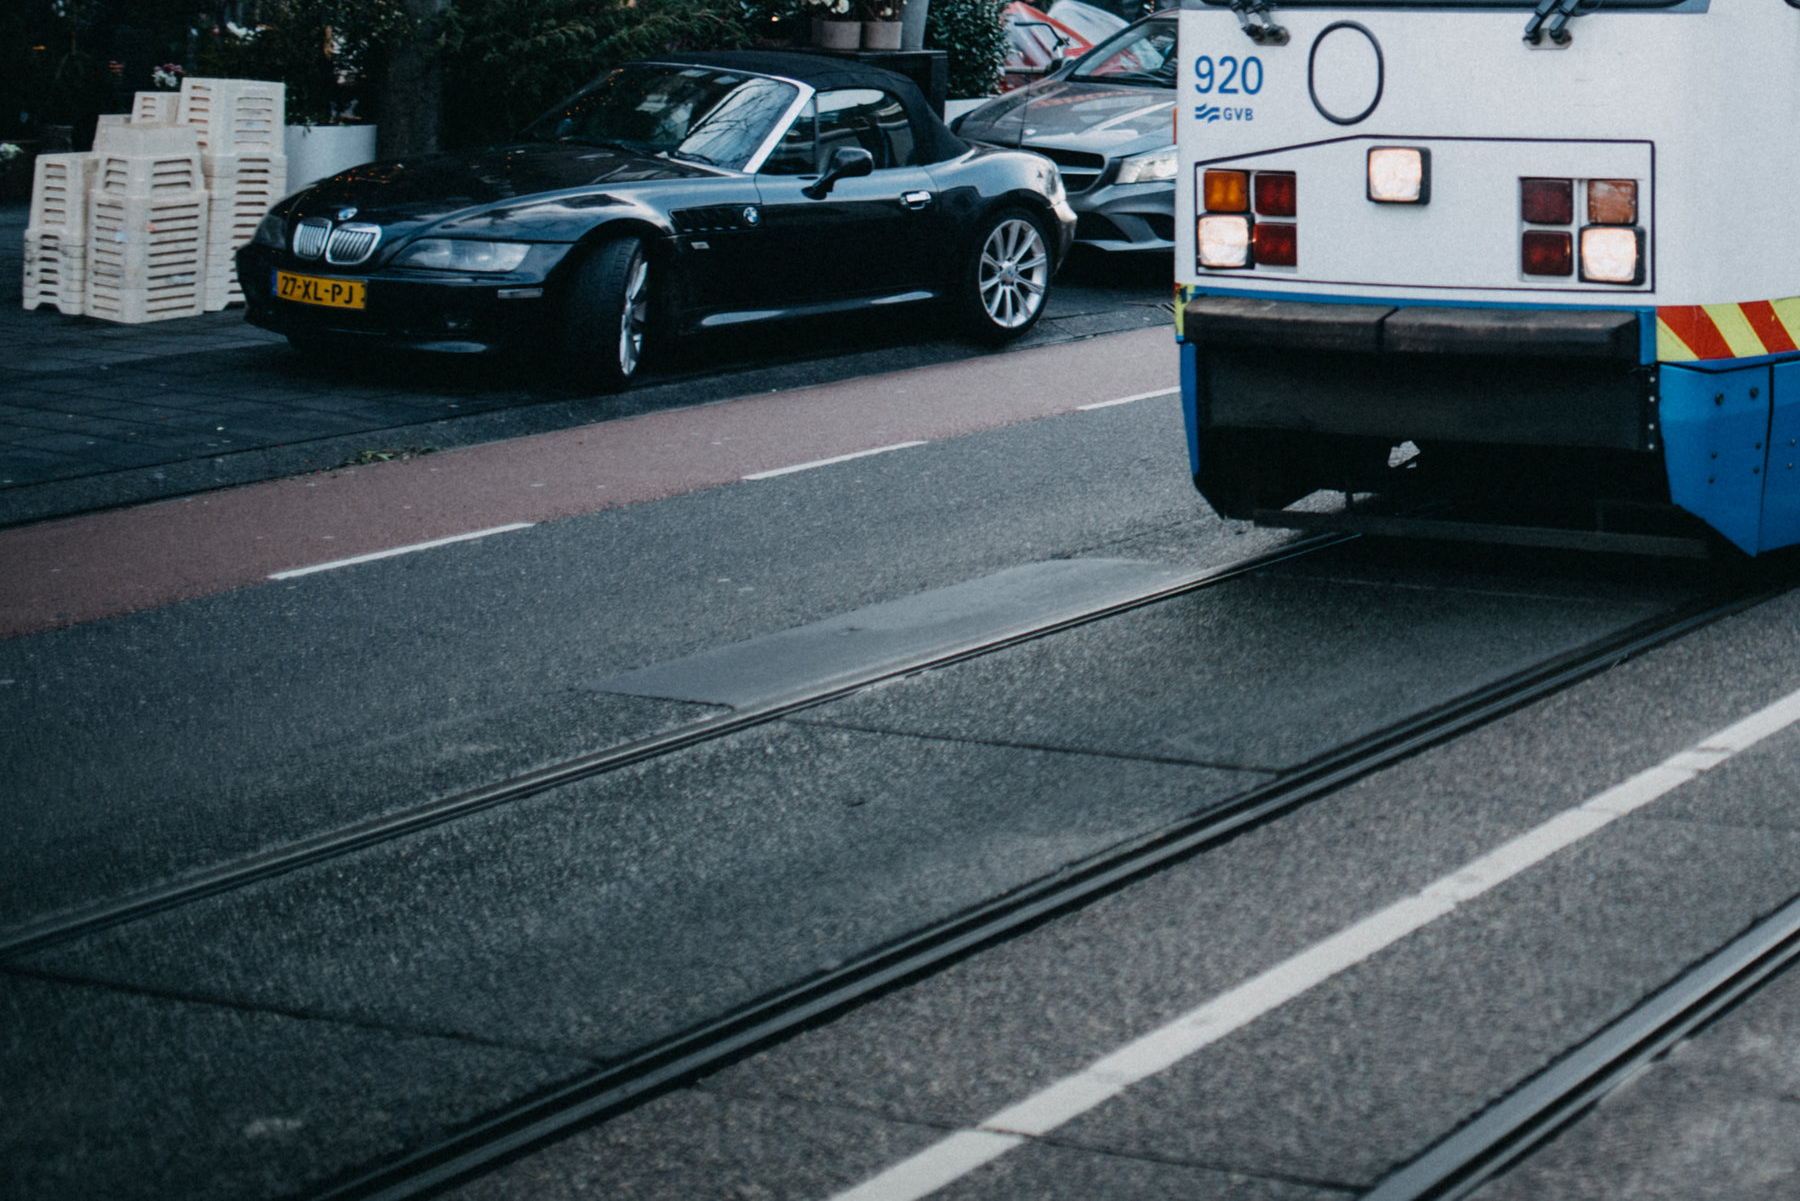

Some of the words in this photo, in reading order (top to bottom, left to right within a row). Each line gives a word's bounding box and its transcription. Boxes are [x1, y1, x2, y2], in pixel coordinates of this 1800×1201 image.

[1194, 55, 1264, 96] 920
[1223, 107, 1254, 121] GVB
[281, 275, 354, 304] 27-XL-PJ
